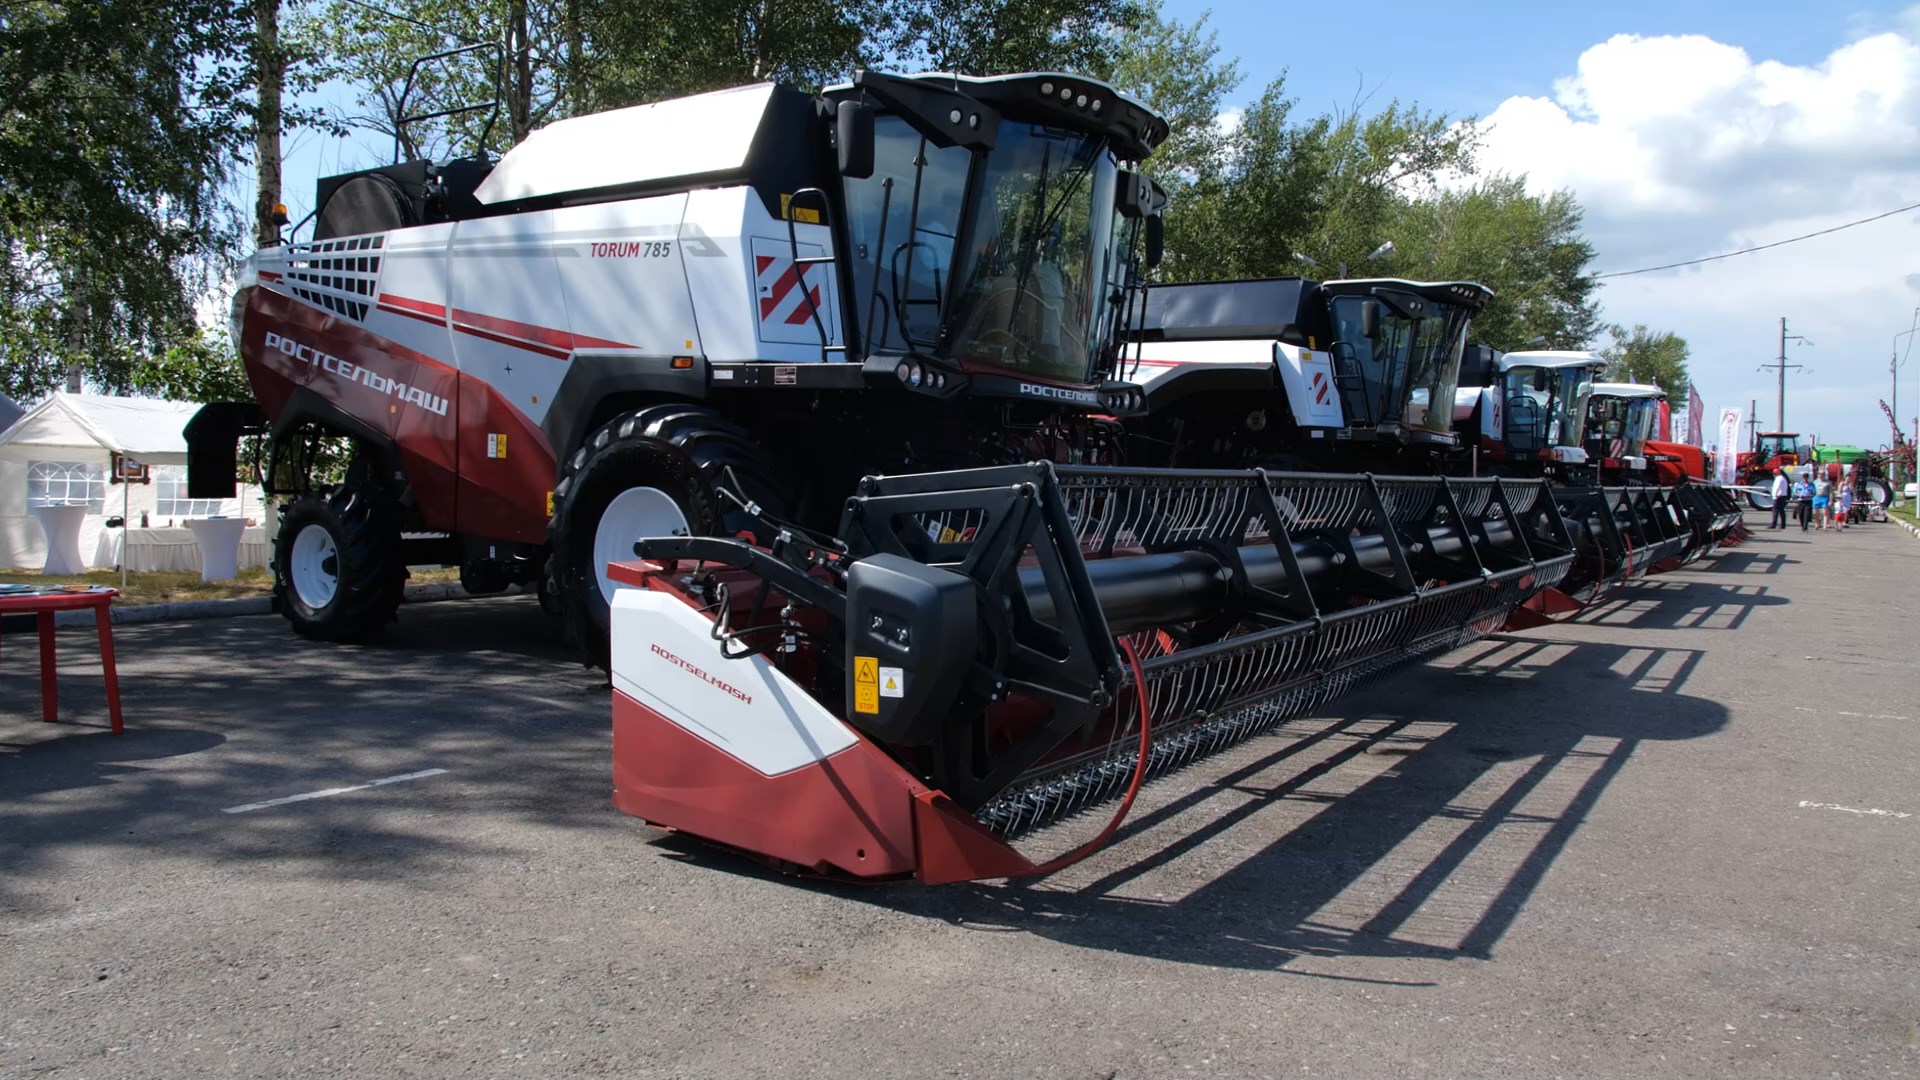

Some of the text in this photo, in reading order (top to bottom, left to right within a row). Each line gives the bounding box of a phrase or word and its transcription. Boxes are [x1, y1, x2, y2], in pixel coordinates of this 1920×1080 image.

[591, 242, 671, 258] TORUM 785
[264, 331, 449, 416] РОСТСЕЛЬМАШ
[651, 643, 752, 705] ROSTSELMASH
